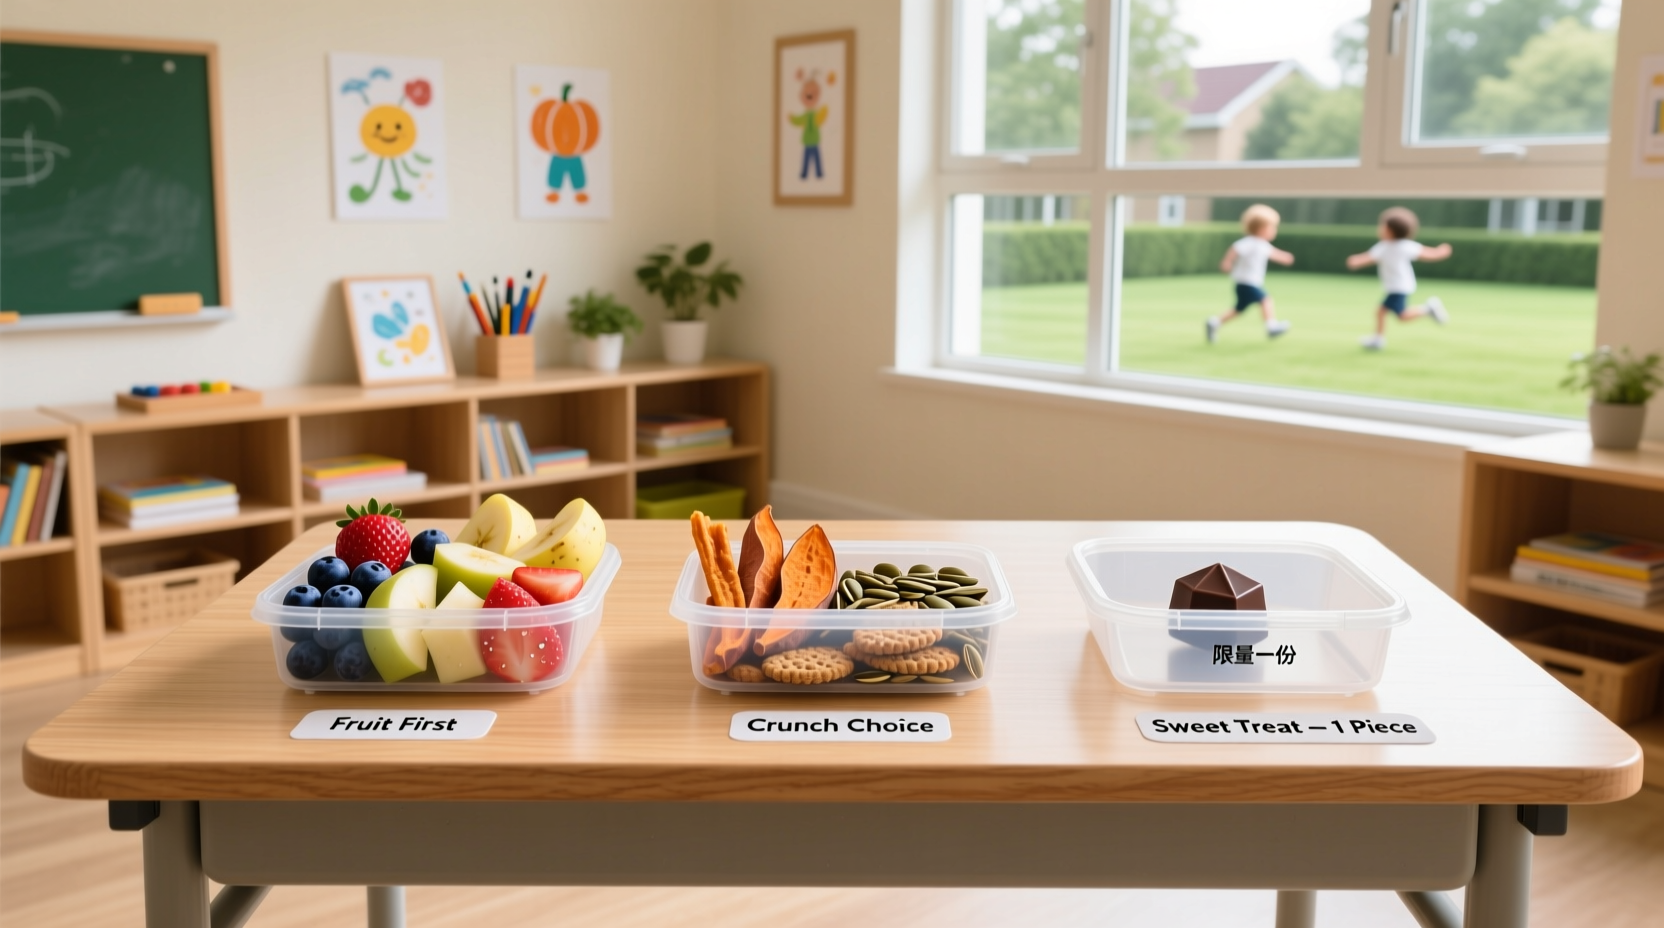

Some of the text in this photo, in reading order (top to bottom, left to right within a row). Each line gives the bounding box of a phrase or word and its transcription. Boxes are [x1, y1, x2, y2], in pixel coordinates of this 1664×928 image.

[1212, 644, 1297, 665] 限量一份
[328, 716, 458, 731] Fruit First
[747, 718, 934, 733] Crunch Choice
[1152, 719, 1231, 733] Sweet
[1233, 719, 1304, 734] Treat
[1330, 720, 1344, 734] 1
[1349, 719, 1417, 734] Piece
